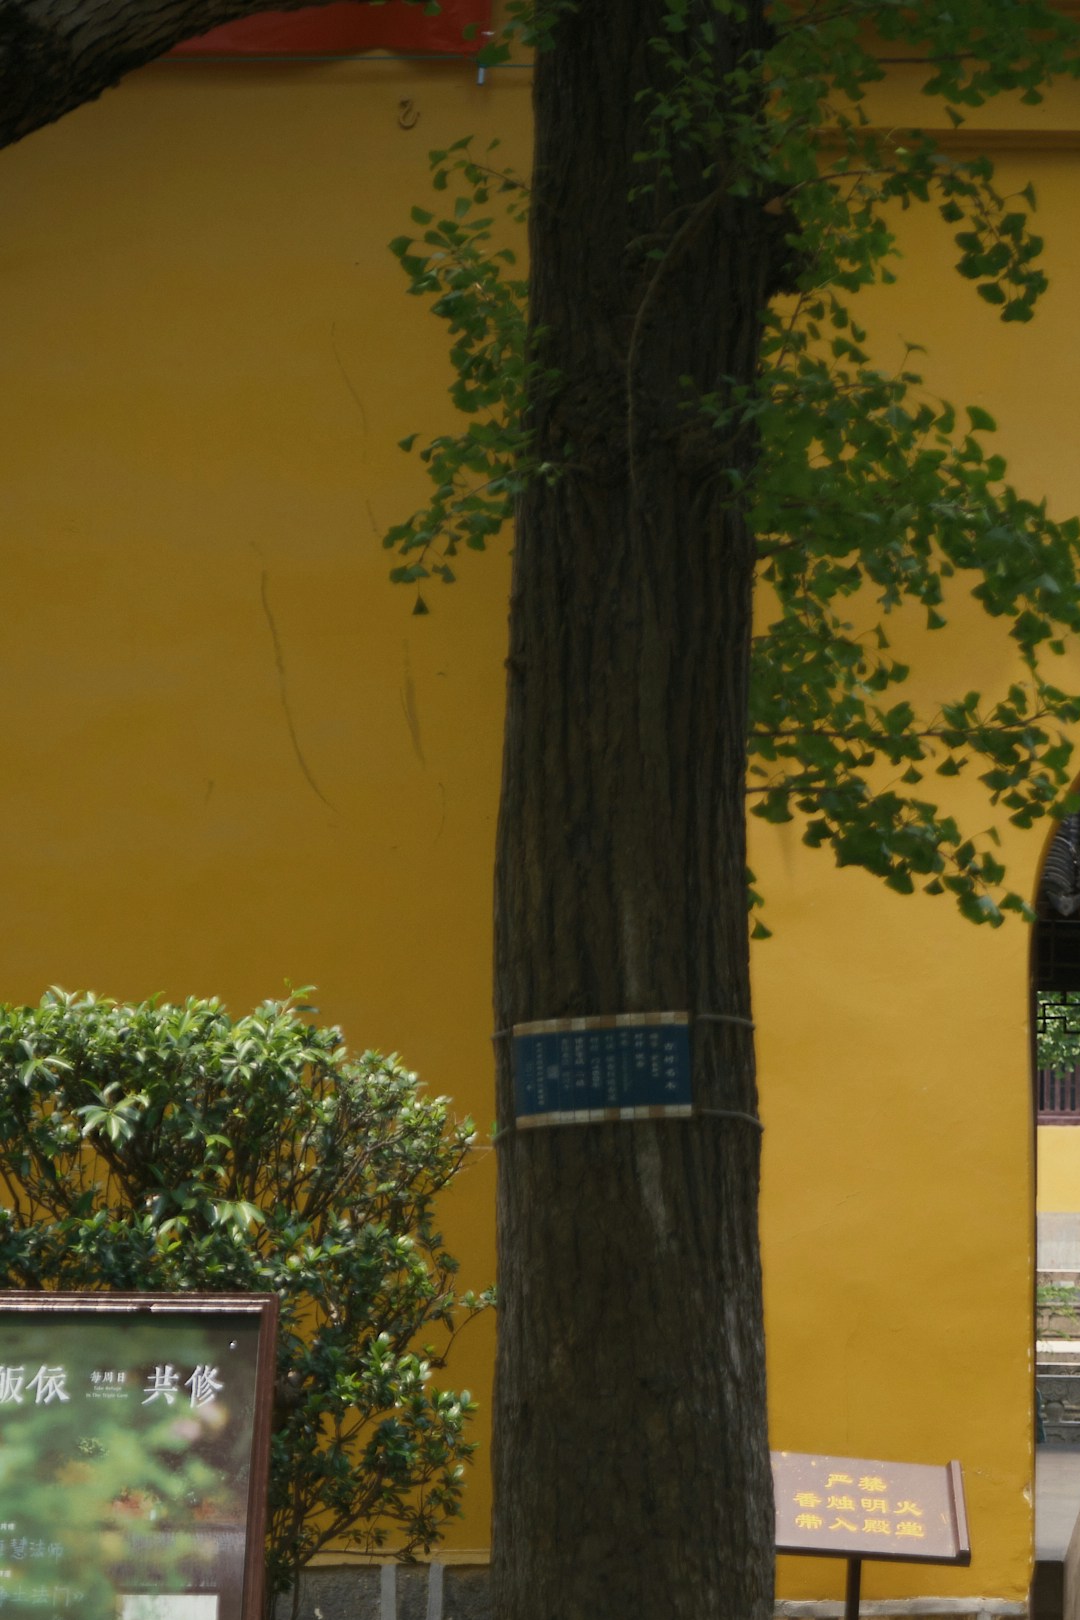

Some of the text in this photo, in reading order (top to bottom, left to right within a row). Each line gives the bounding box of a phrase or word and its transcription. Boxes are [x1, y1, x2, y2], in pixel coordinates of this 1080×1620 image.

[141, 1363, 224, 1409] 共修
[824, 1472, 888, 1493] 严禁
[792, 1491, 925, 1518] 香烛明火
[793, 1512, 926, 1538] 带入殿堂
